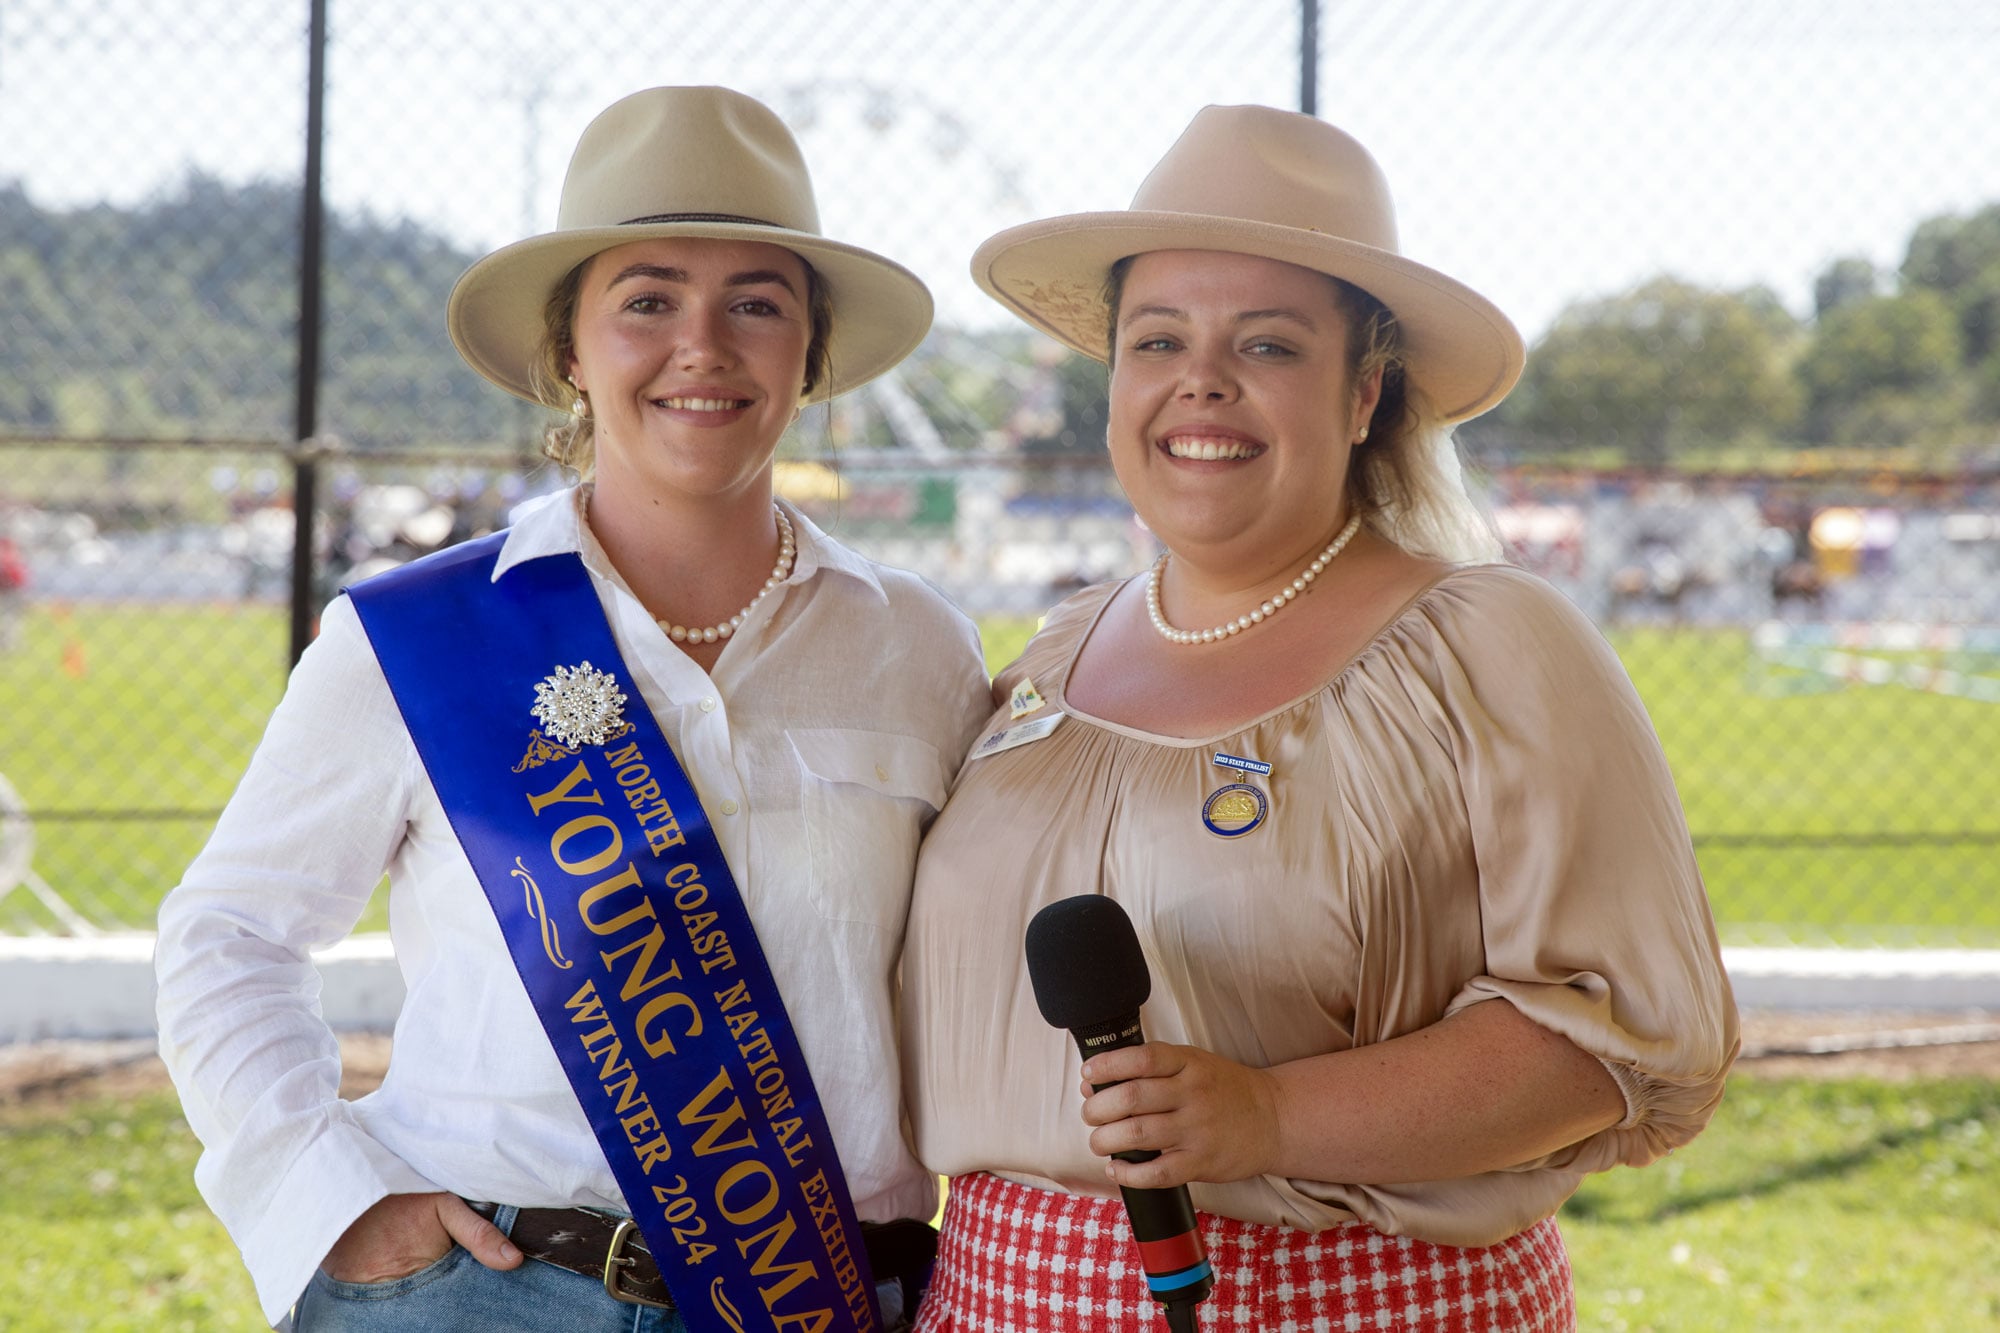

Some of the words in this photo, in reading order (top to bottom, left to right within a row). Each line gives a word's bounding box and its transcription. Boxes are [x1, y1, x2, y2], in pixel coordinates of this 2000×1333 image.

[525, 759, 704, 1060] YOUNG
[1228, 758, 1245, 768] STATE
[1245, 761, 1269, 773] FINALIST
[604, 741, 687, 858] NORTH
[664, 862, 738, 976] COAST
[713, 978, 815, 1169] NATIONAL
[1084, 1032, 1117, 1047] MIPRO
[563, 978, 673, 1176] WINNER
[652, 1173, 719, 1266] 2024
